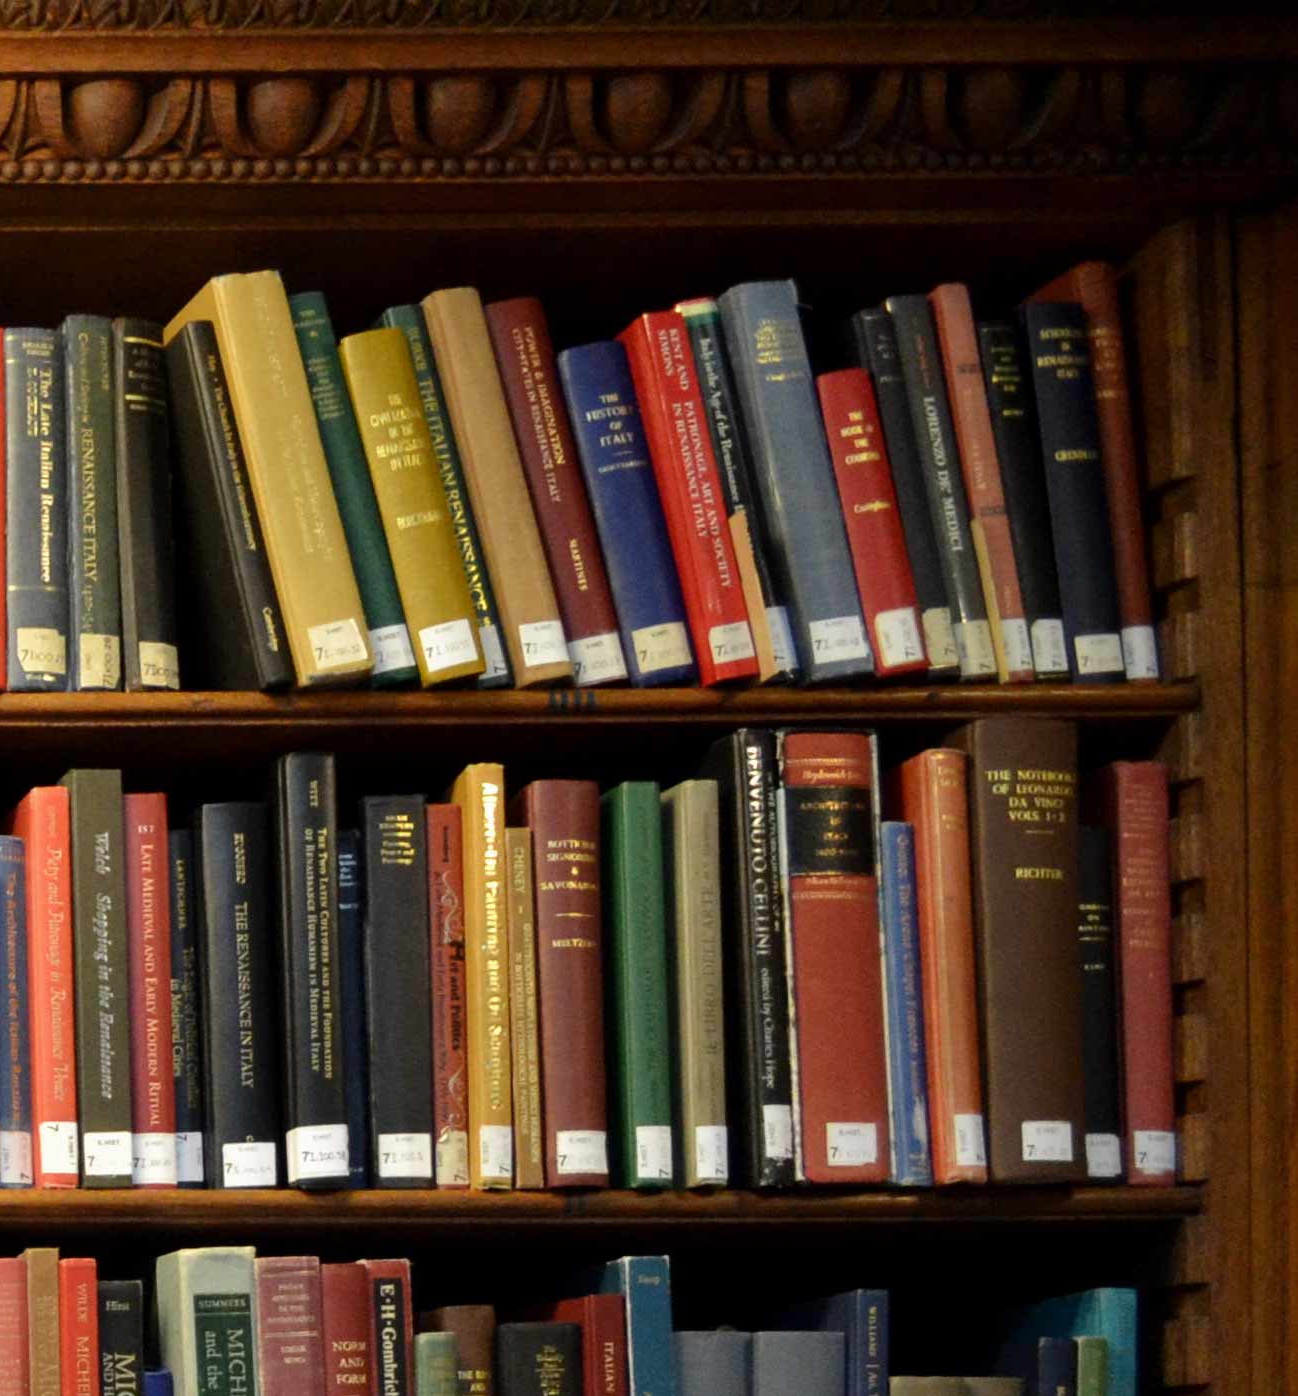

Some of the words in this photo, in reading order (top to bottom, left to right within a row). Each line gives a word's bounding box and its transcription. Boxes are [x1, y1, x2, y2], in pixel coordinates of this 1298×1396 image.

[924, 397, 946, 466] LORENZO
[943, 497, 963, 552] MEDICI
[234, 901, 247, 930] THE
[236, 932, 251, 1024] RENAISSANCE
[238, 1026, 252, 1045] IN
[205, 1332, 220, 1359] and
[207, 1362, 220, 1389] the
